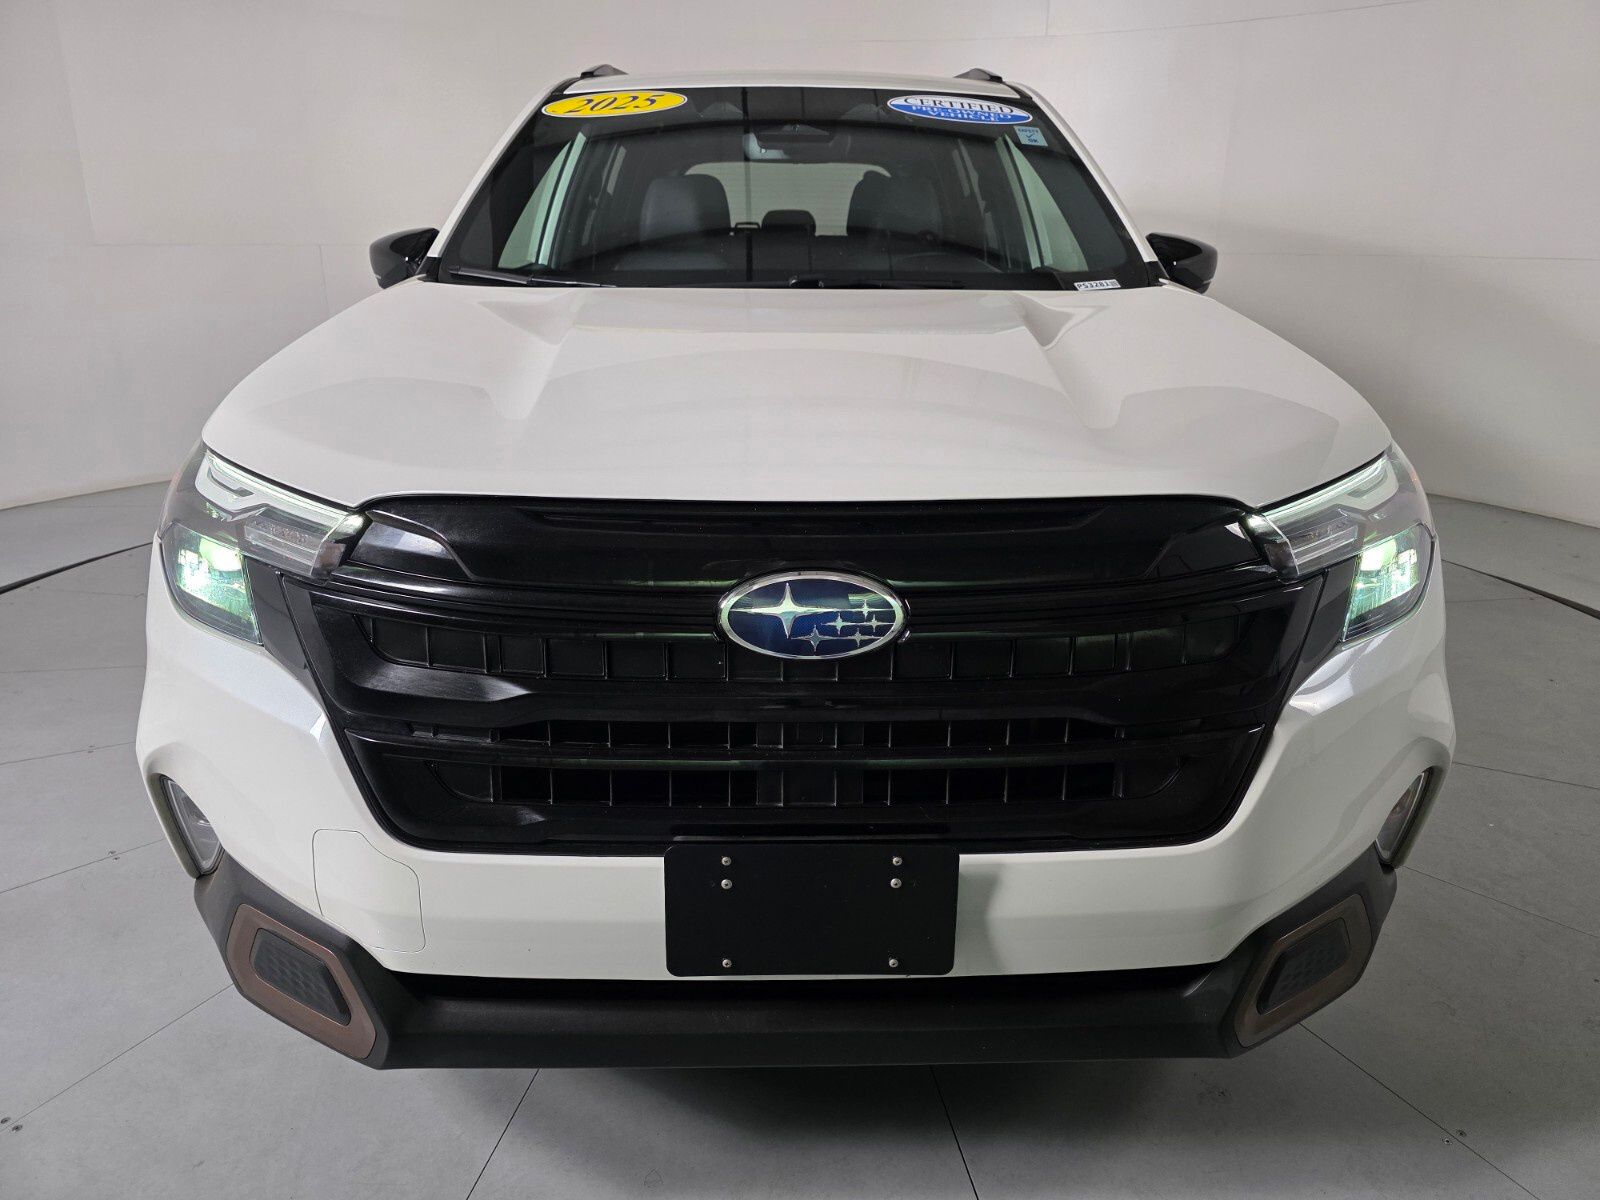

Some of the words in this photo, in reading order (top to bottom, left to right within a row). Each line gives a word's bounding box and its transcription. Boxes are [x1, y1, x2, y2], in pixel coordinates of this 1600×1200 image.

[564, 94, 665, 114] 2025
[904, 97, 1014, 114] CERTIFIED
[912, 105, 1012, 119] PRE-OWNED
[928, 111, 1000, 122] VEHICLE
